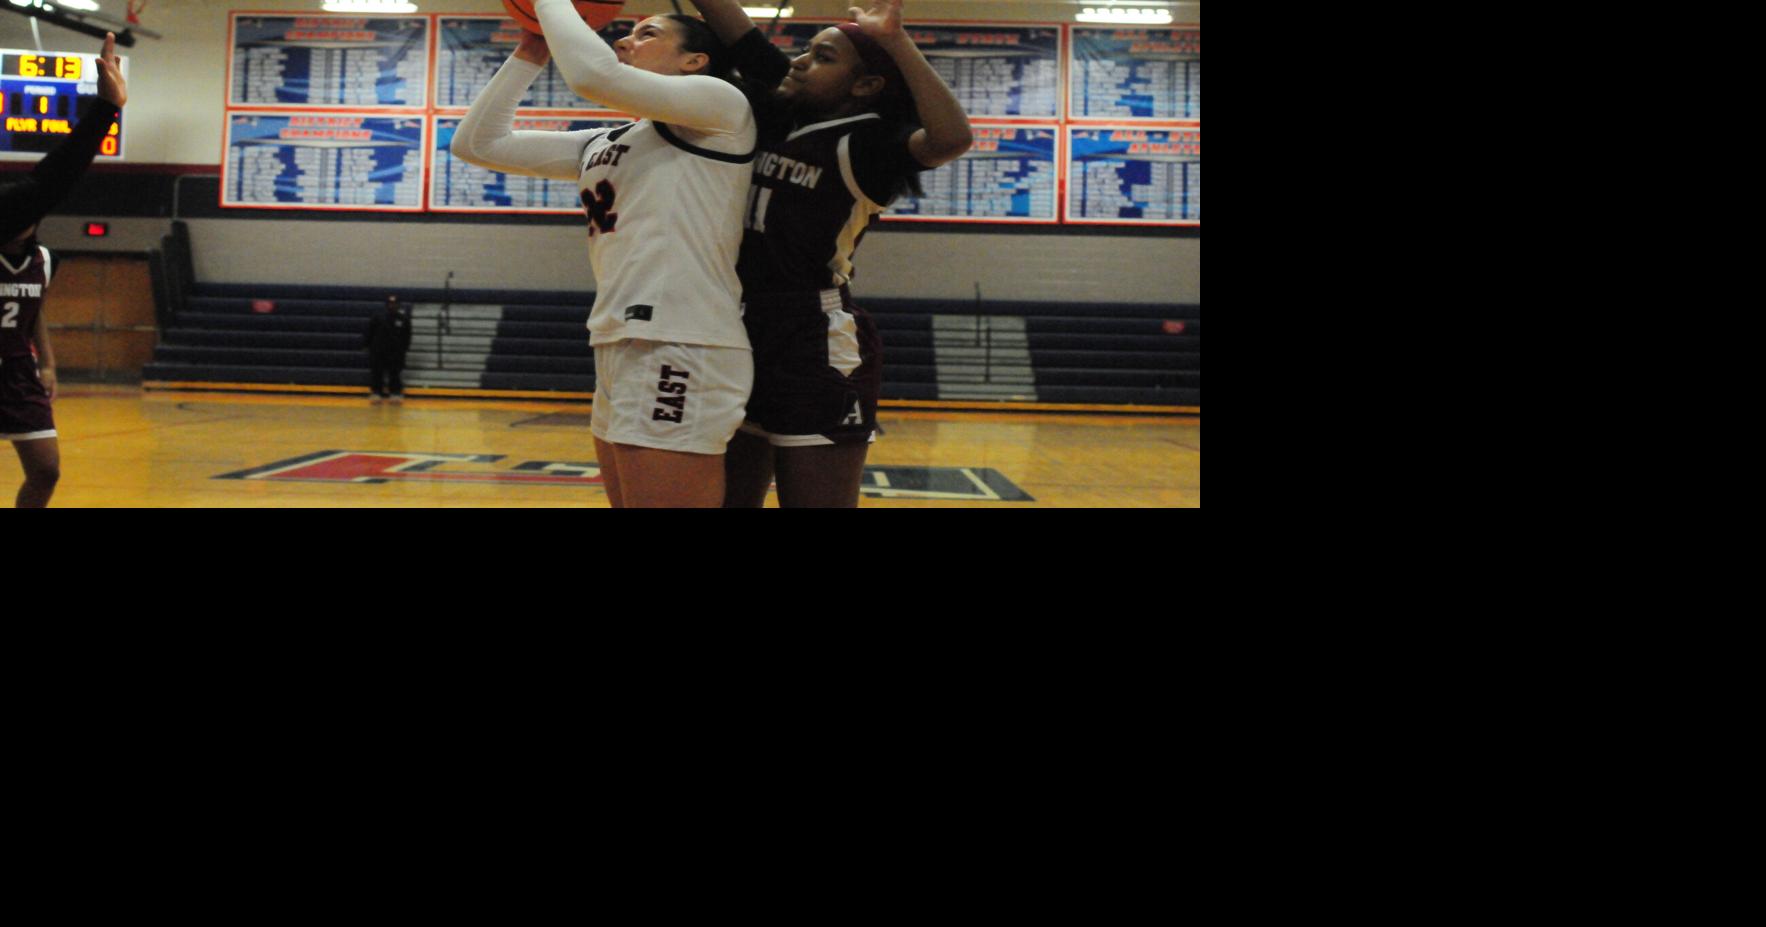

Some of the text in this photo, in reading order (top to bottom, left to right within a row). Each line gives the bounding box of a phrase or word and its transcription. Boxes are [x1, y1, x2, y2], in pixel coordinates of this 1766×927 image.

[19, 54, 82, 80] 6:13
[101, 136, 118, 156] 0
[280, 129, 372, 140] CHAMPIONS
[586, 144, 631, 171] EAST
[652, 364, 690, 424] EAST
